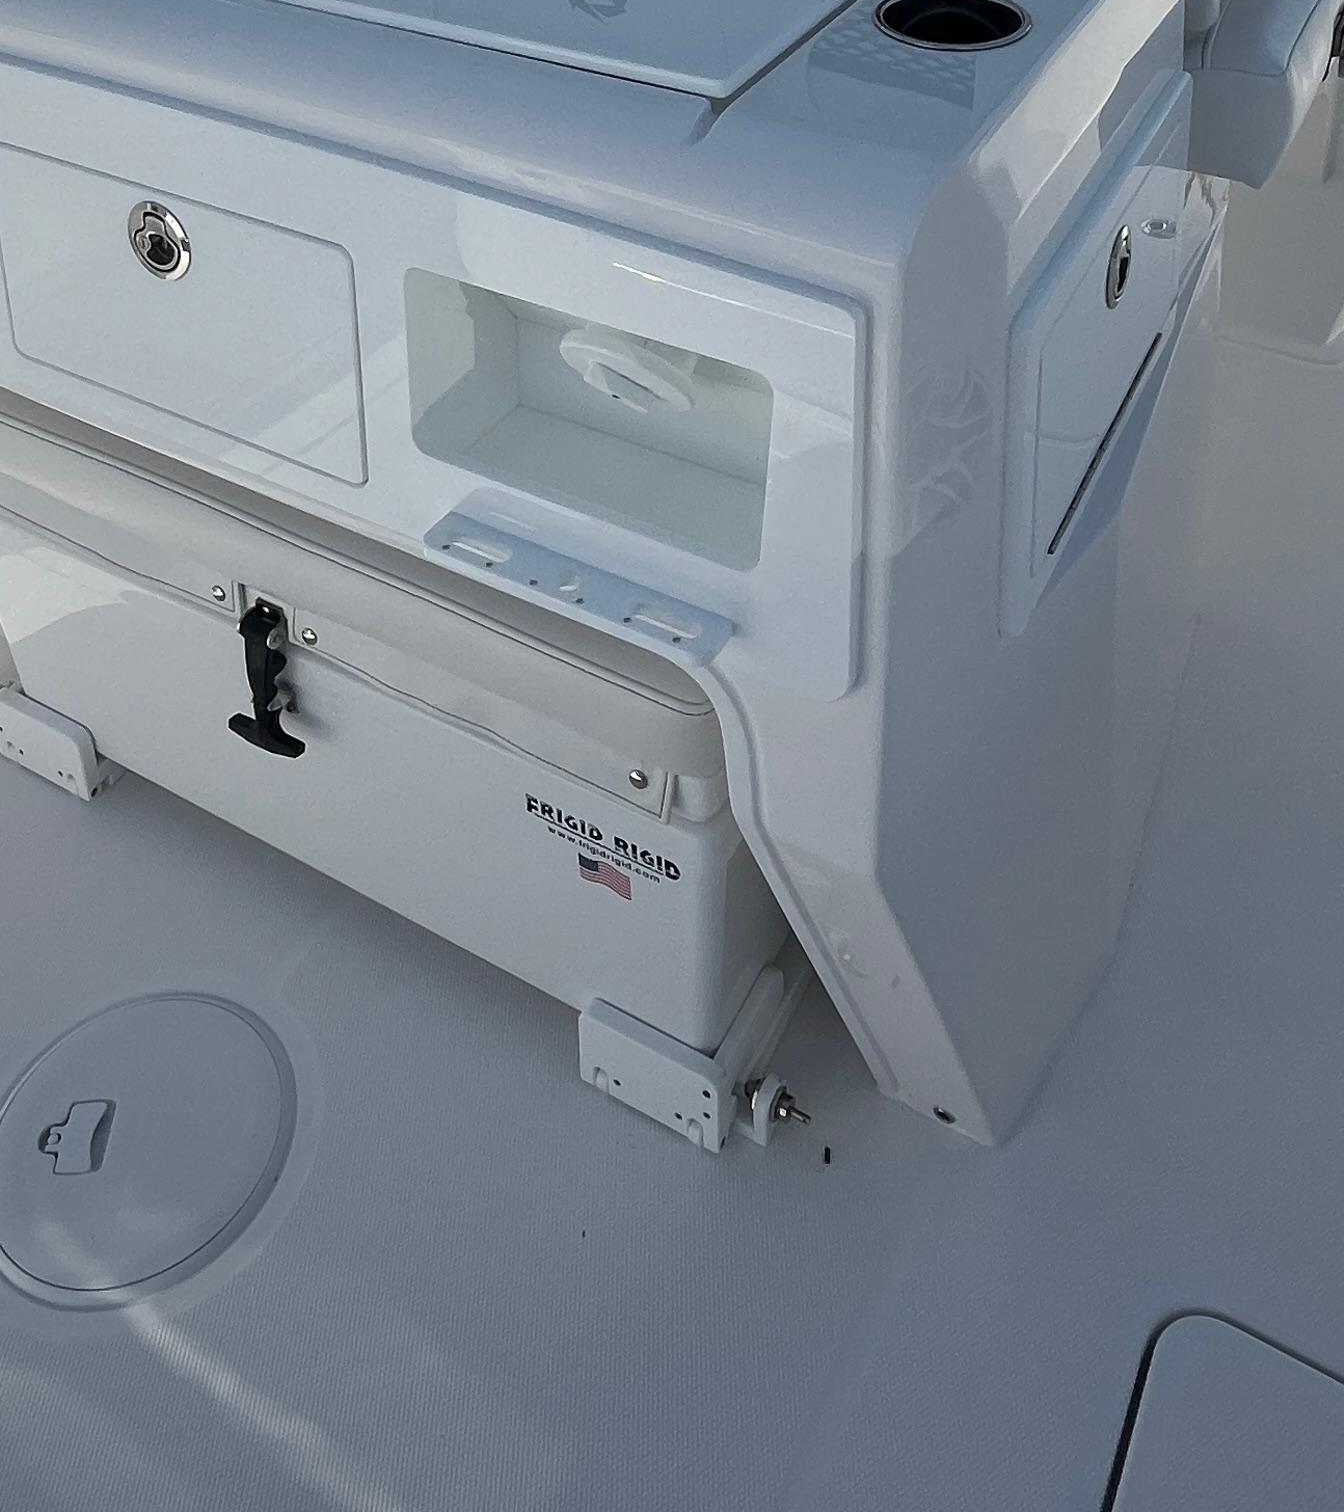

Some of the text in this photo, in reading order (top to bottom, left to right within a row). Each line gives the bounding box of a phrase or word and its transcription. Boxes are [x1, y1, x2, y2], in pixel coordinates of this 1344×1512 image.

[525, 792, 682, 881] FRIGID RIGID
[547, 825, 662, 884] www.frigidrigid.com
